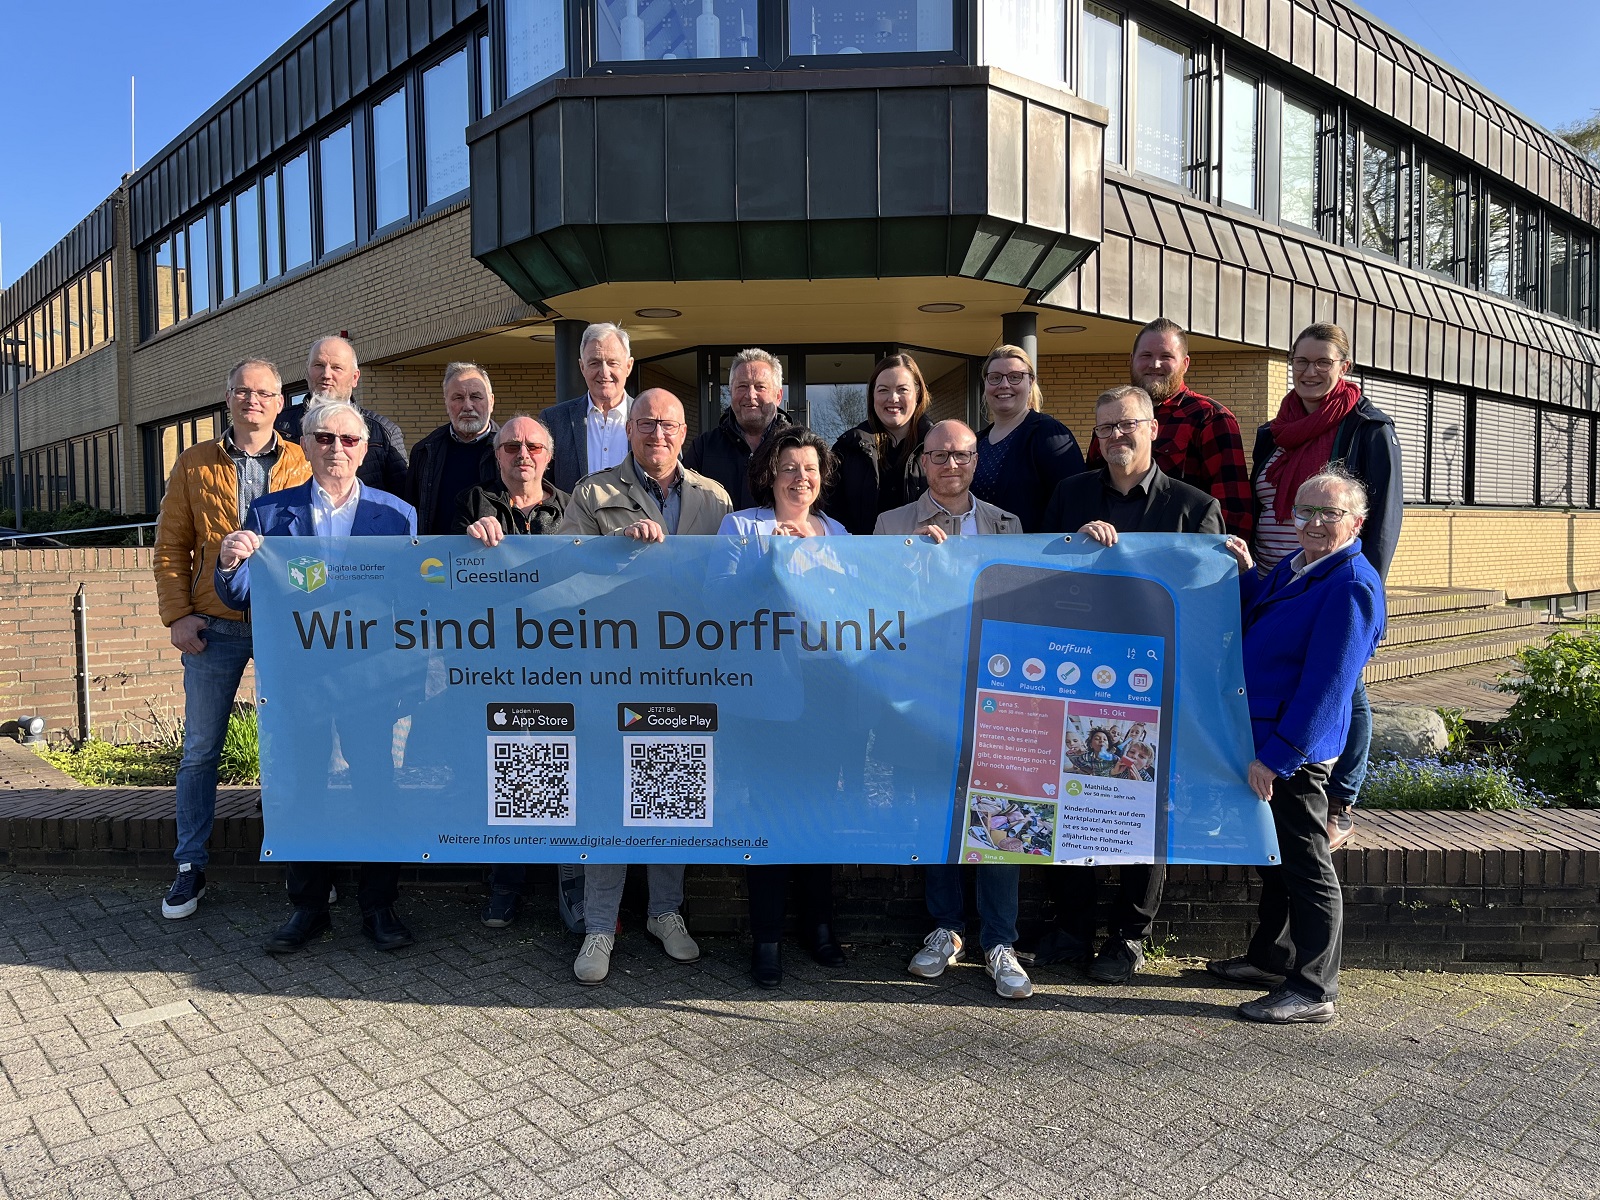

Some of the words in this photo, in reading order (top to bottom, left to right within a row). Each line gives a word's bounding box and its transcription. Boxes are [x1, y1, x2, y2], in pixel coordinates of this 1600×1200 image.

[456, 558, 486, 566] STADT
[327, 564, 358, 573] Digitale
[360, 563, 385, 572] Dörfer
[327, 573, 385, 581] Niedersachsen
[456, 569, 540, 584] Geestland
[292, 609, 378, 650] Wir
[395, 608, 496, 650] sind
[515, 608, 638, 650] beim
[657, 608, 908, 651] DorfFunk!
[1048, 642, 1093, 654] DorfFunk
[449, 667, 515, 686] Direkt
[521, 667, 583, 686] laden
[589, 667, 633, 686] und
[639, 667, 754, 687] mitfunken
[1019, 682, 1046, 692] Plausch
[1094, 691, 1112, 699] Hilfe
[1127, 694, 1152, 702] Events
[1099, 708, 1110, 716] 15.
[1111, 709, 1126, 717] Okt
[511, 715, 535, 727] App
[536, 715, 568, 726] Store
[647, 715, 688, 728] Google
[689, 715, 712, 728] Play
[1021, 727, 1037, 735] kann
[978, 741, 1004, 750] Bäckerei
[1003, 755, 1031, 764] sonntags
[1084, 783, 1112, 791] Mathilda
[1064, 804, 1117, 815] Kinderflohmarkt
[1063, 814, 1101, 823] Marktplatz!
[1113, 819, 1142, 828] Sonntag
[438, 834, 480, 845] Weitere
[482, 834, 511, 845] Infos
[513, 835, 547, 846] unter:
[549, 835, 769, 849] www.digitale-doerfer-niedersachsen.de
[1062, 833, 1098, 842] alljährliche
[1099, 836, 1134, 846] Flohmarkt
